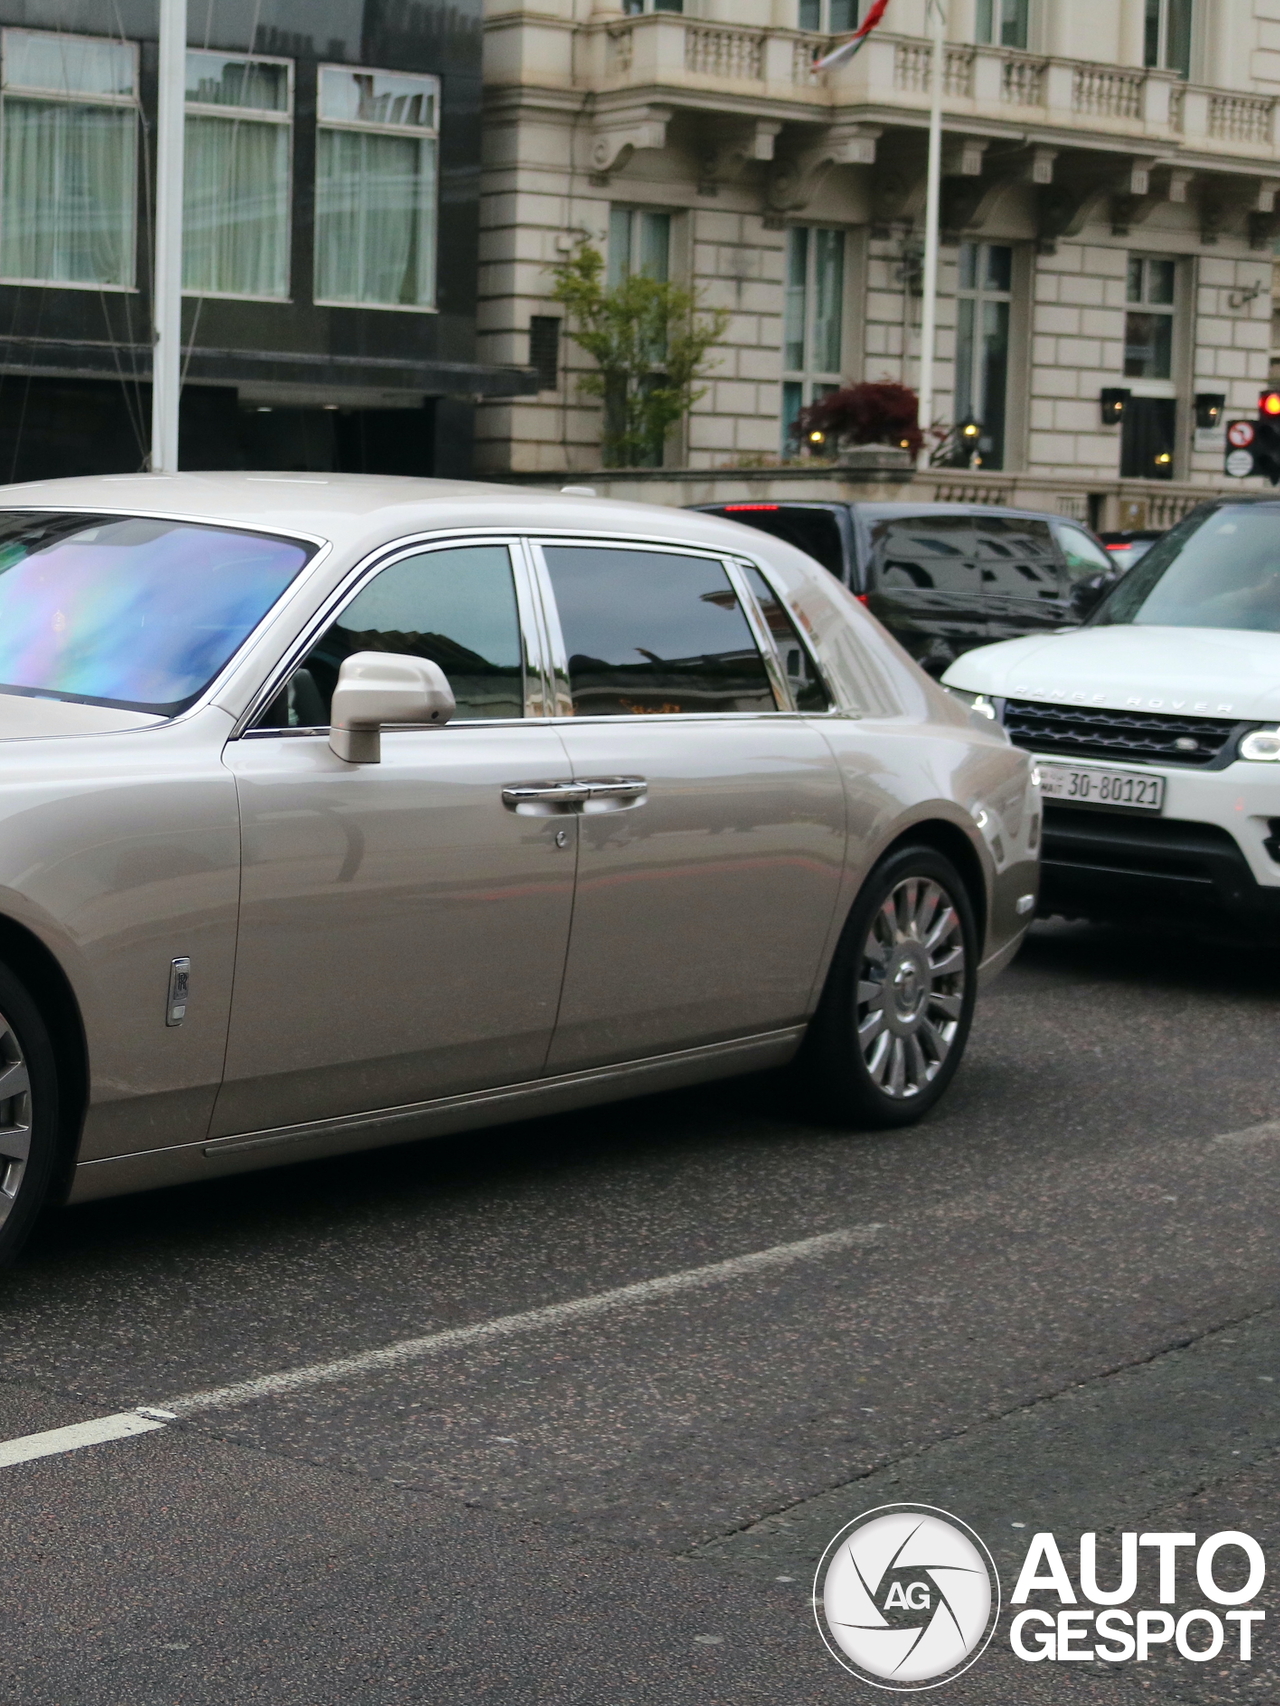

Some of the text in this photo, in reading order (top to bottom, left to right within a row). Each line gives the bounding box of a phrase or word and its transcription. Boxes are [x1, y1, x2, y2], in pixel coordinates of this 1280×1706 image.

[1014, 686, 1234, 714] RANGE ROVER
[1068, 772, 1158, 805] 30-80121
